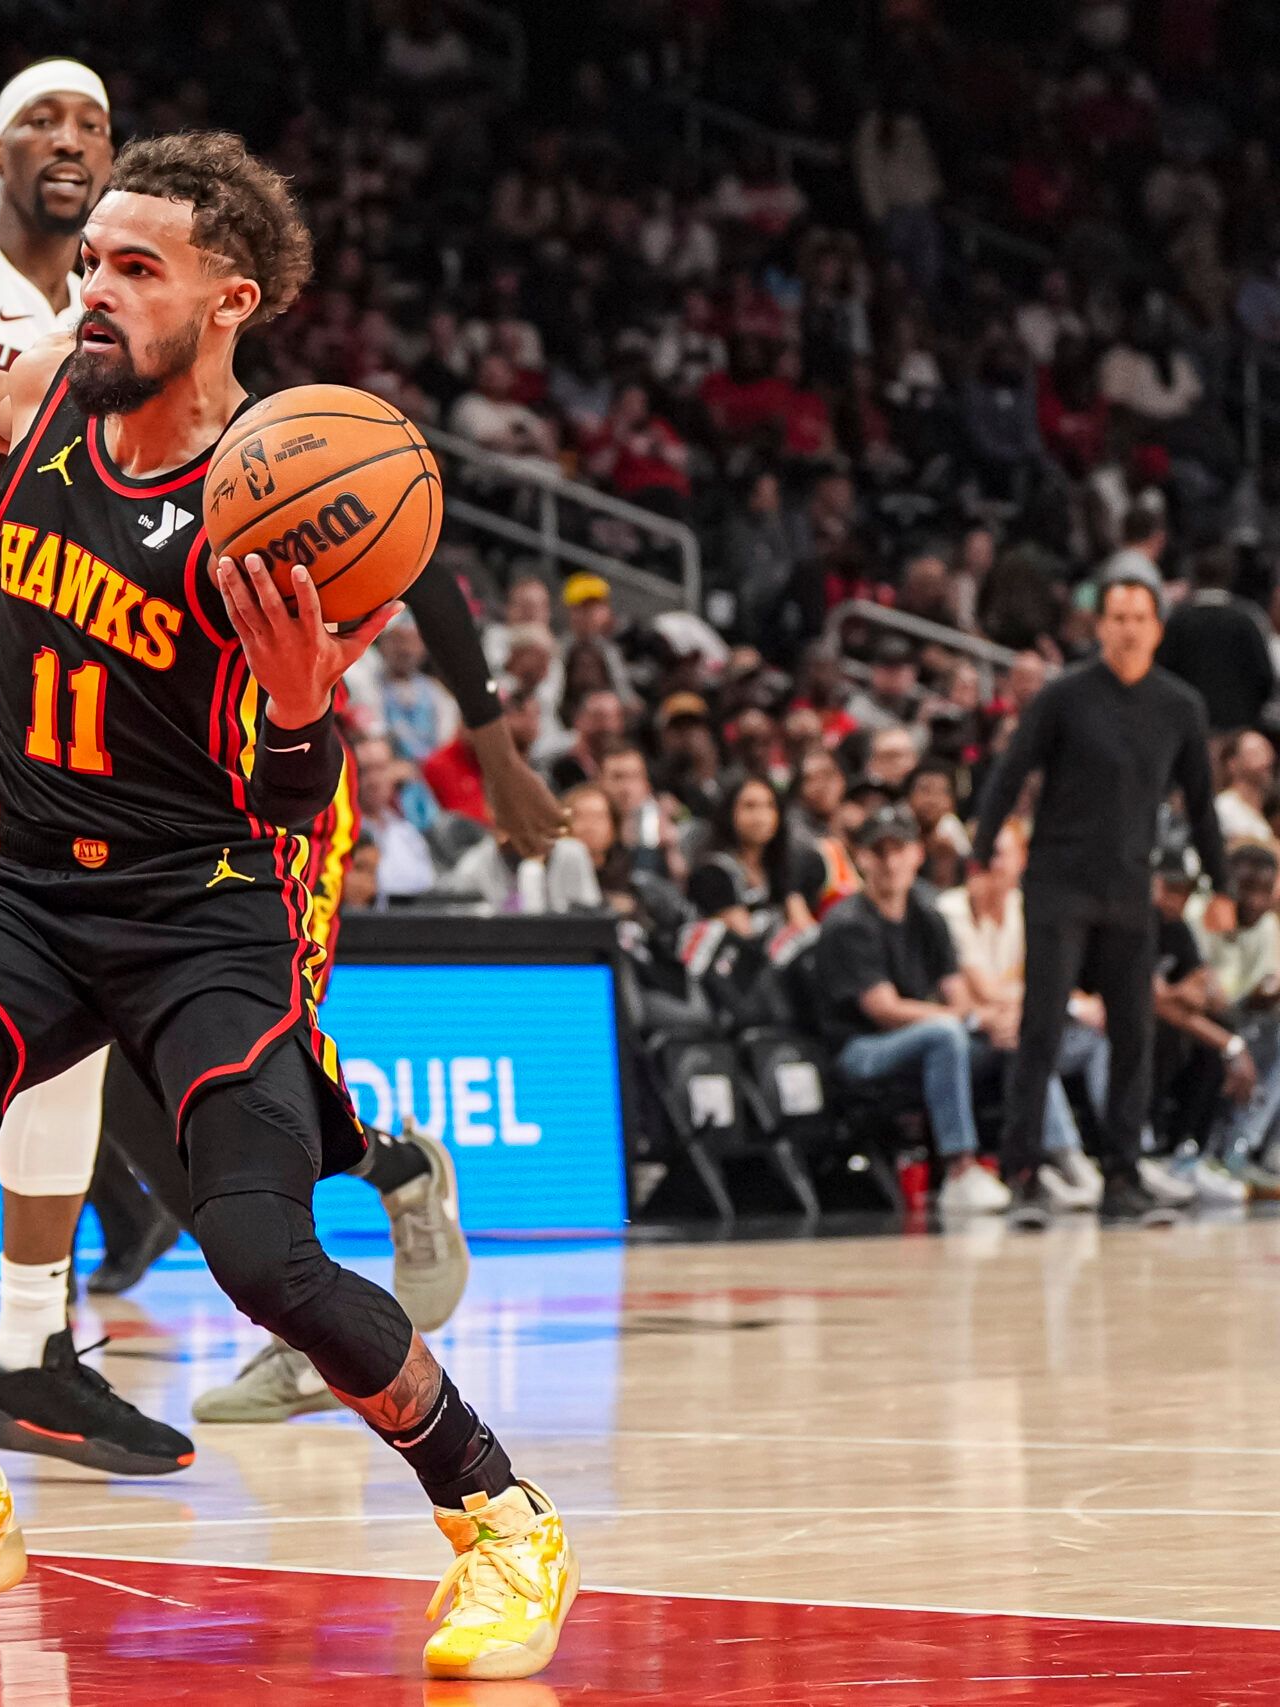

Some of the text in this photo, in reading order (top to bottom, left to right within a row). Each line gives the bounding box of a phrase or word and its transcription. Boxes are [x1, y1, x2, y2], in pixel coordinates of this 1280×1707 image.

[138, 514, 154, 529] the
[238, 492, 377, 574] Wils
[0, 521, 184, 671] HAWKS
[25, 646, 112, 776] 11
[78, 842, 104, 857] ATL
